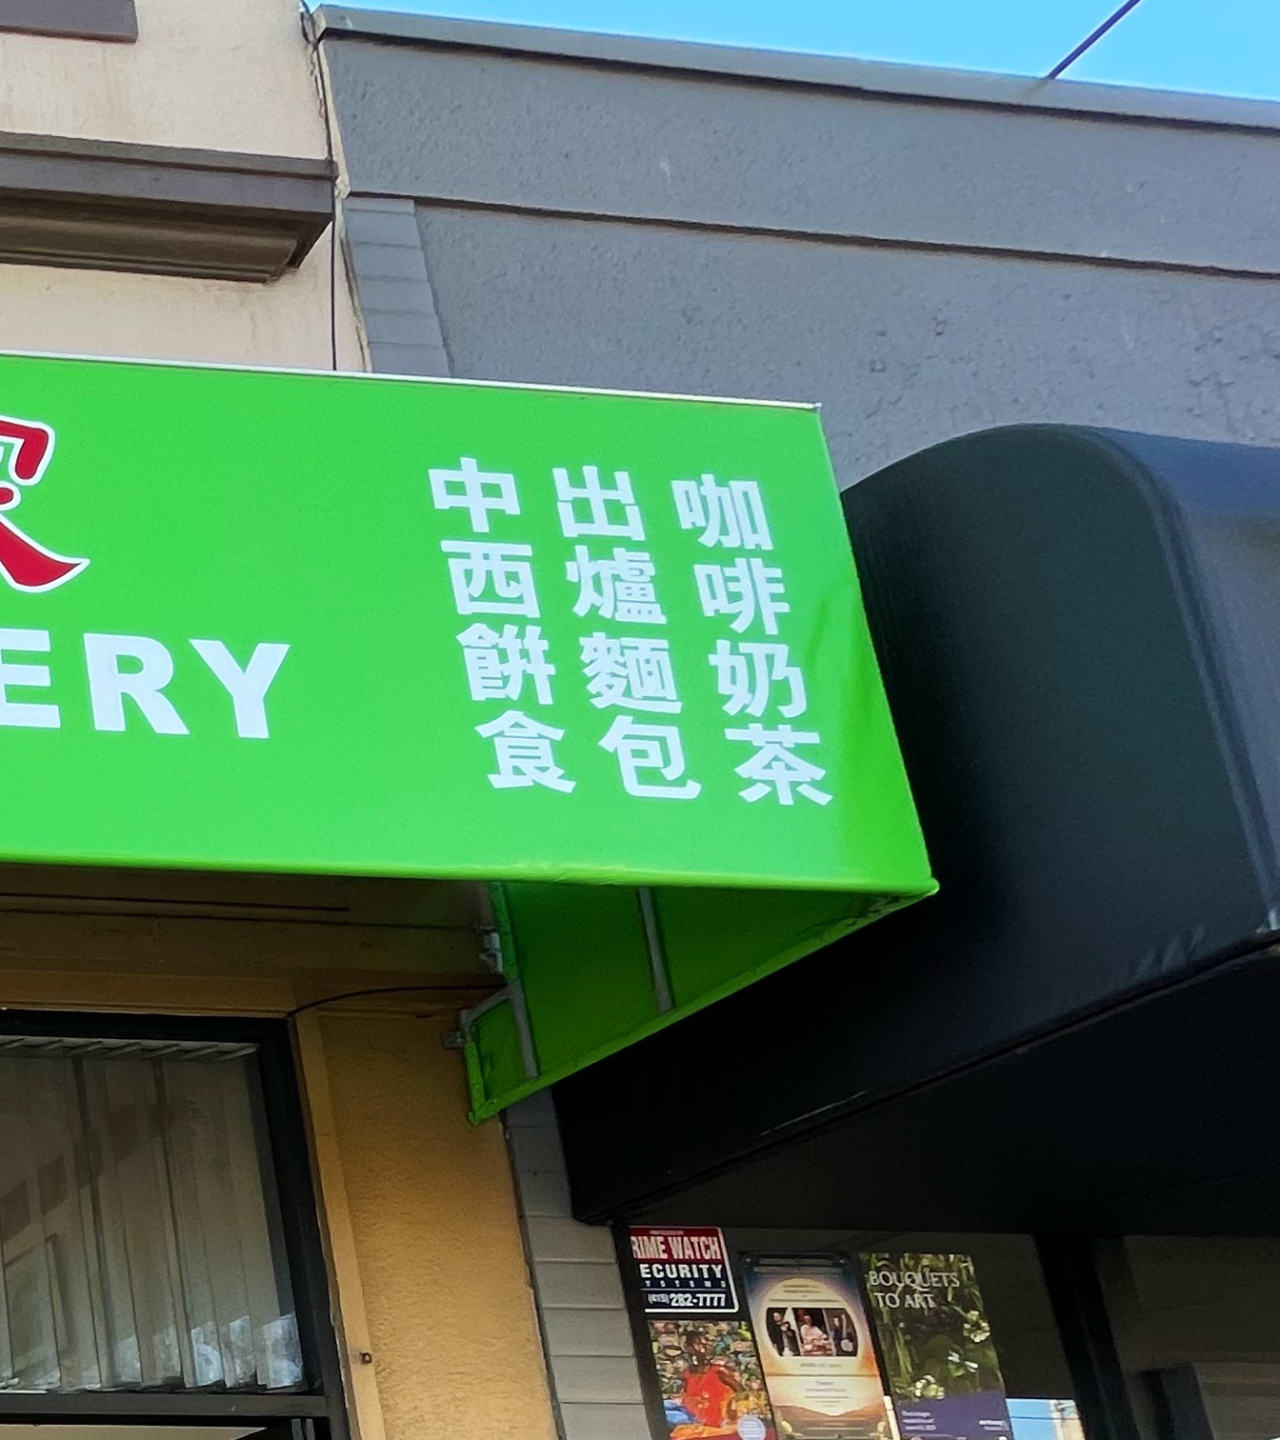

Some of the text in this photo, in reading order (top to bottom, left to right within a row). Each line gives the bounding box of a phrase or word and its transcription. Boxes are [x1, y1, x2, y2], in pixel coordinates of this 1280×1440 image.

[427, 457, 577, 794] 中西餅食
[552, 464, 702, 800] 出爐麵包
[670, 473, 833, 806] 咖啡奶茶
[630, 1235, 723, 1260] RIME WATCH
[639, 1263, 723, 1279] ECURITY
[868, 1269, 960, 1291] BOUQUETS
[874, 1292, 937, 1309] TO ART
